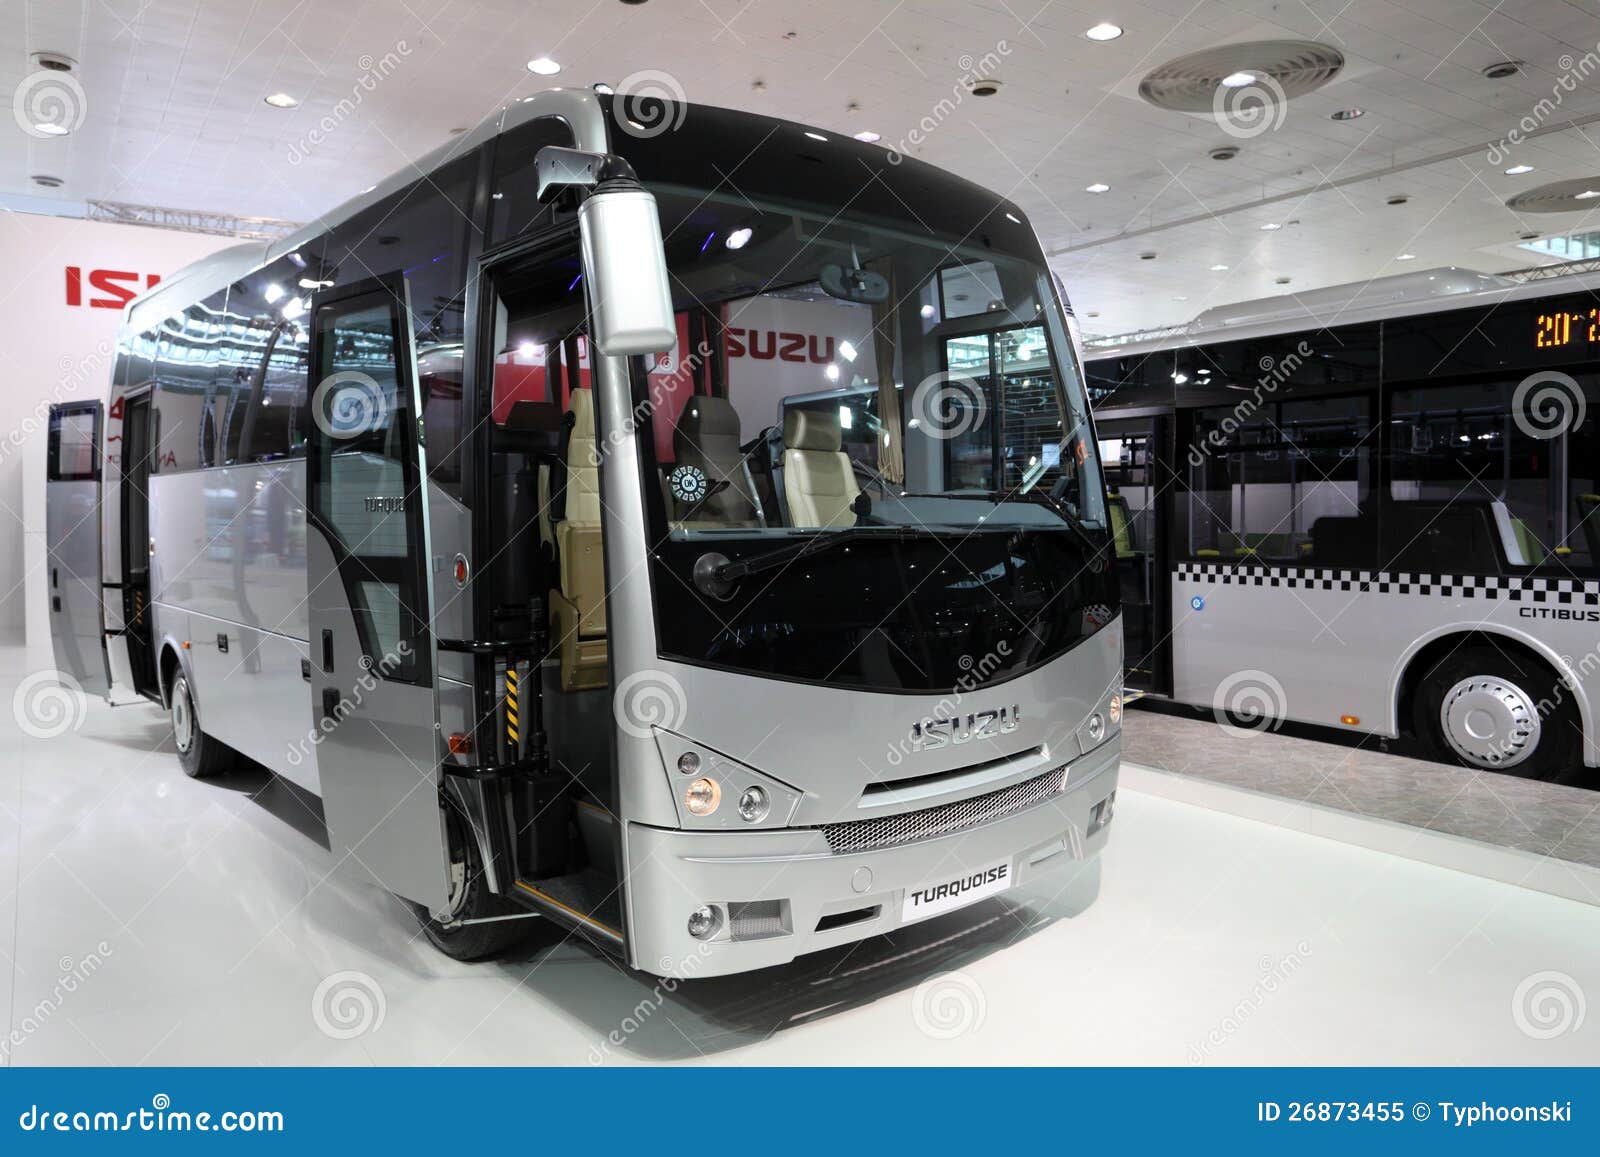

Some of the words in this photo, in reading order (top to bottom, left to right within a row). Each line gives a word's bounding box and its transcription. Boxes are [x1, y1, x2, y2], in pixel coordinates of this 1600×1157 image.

[1519, 607, 1600, 622] CITIBUS
[912, 703, 1020, 752] ISUZU
[911, 864, 1008, 906] TURQUOISE
